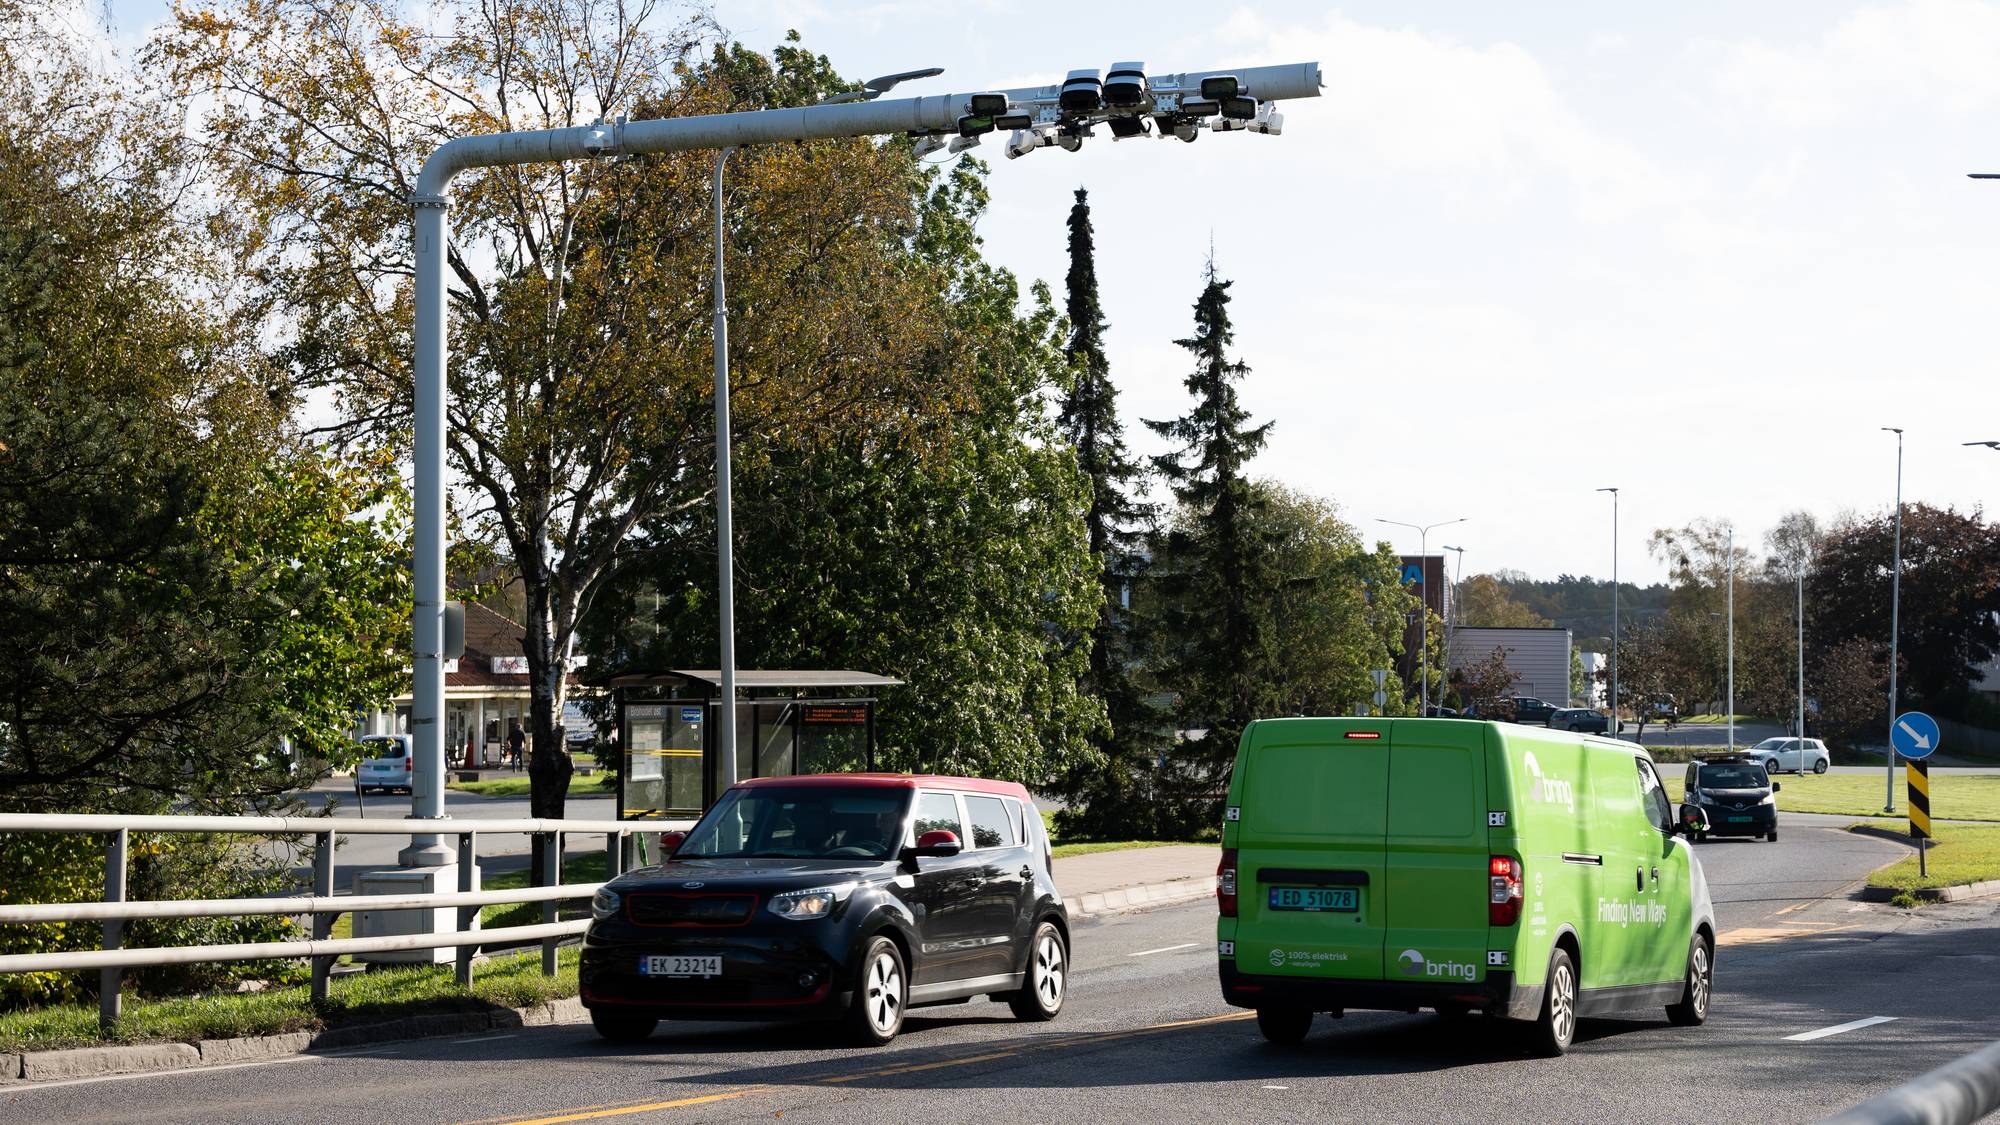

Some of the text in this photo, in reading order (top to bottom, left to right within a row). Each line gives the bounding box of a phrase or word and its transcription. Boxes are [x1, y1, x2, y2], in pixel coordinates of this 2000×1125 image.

[1542, 771, 1575, 813] bring
[1283, 890, 1352, 906] ED 51078
[1598, 897, 1667, 928] Finding New Ways
[651, 958, 717, 973] EK 23214
[1288, 951, 1349, 961] 100% elektrisk
[1426, 959, 1476, 981] bring
